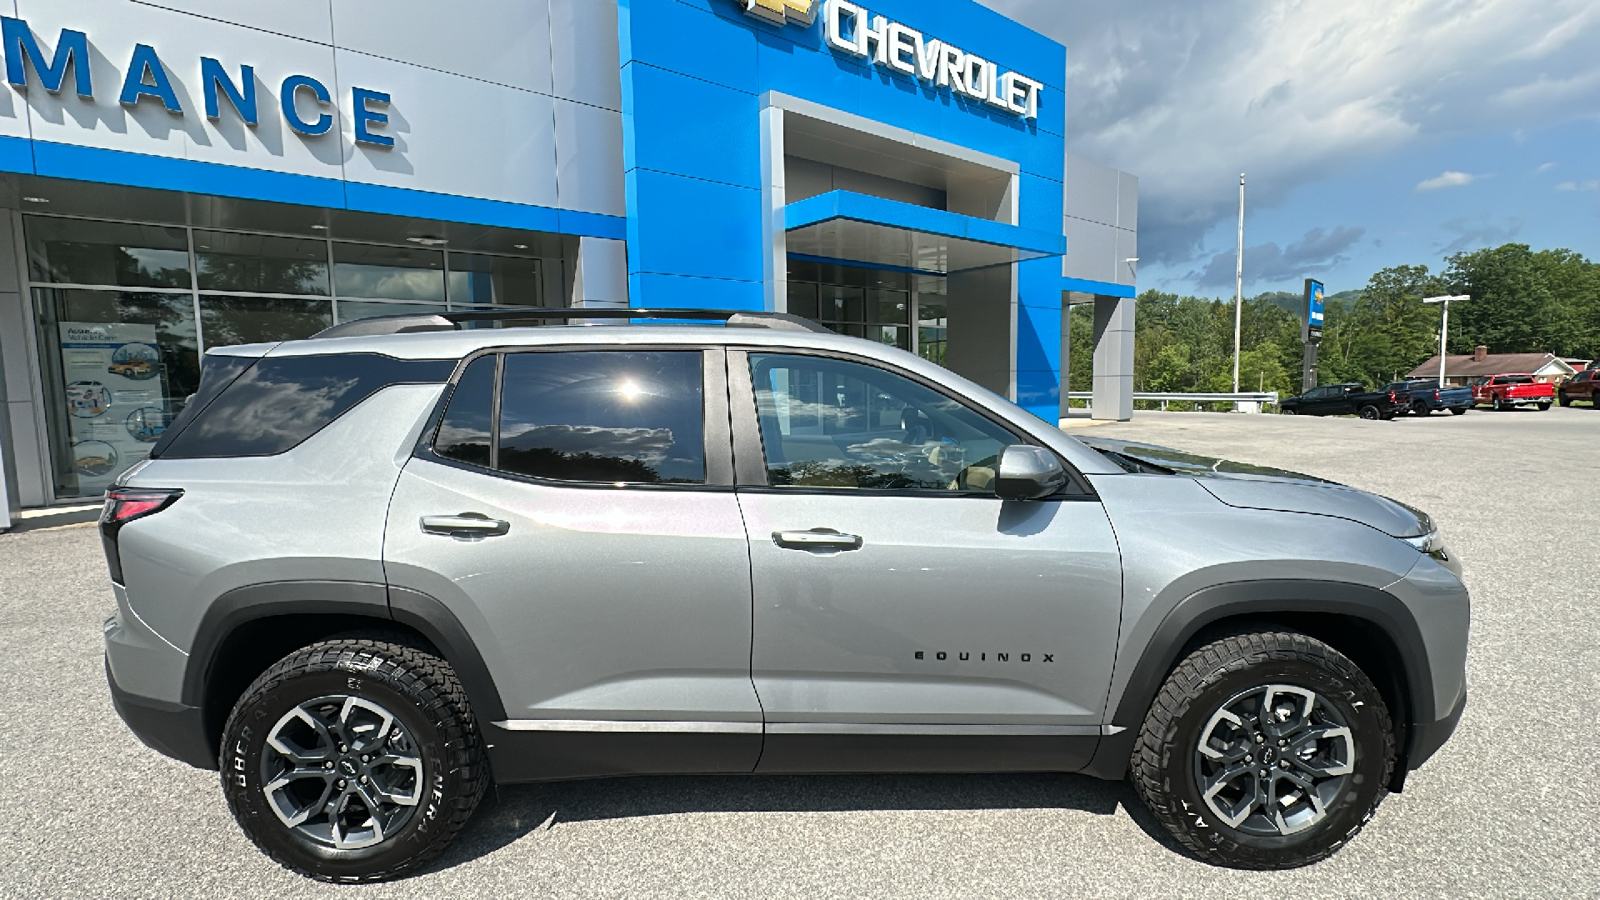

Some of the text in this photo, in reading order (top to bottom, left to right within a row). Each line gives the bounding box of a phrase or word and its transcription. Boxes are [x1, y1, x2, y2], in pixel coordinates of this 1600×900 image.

[0, 15, 395, 149] MANCE
[823, 0, 1043, 120] CHEVROLET
[914, 651, 1054, 663] EQUINOX
